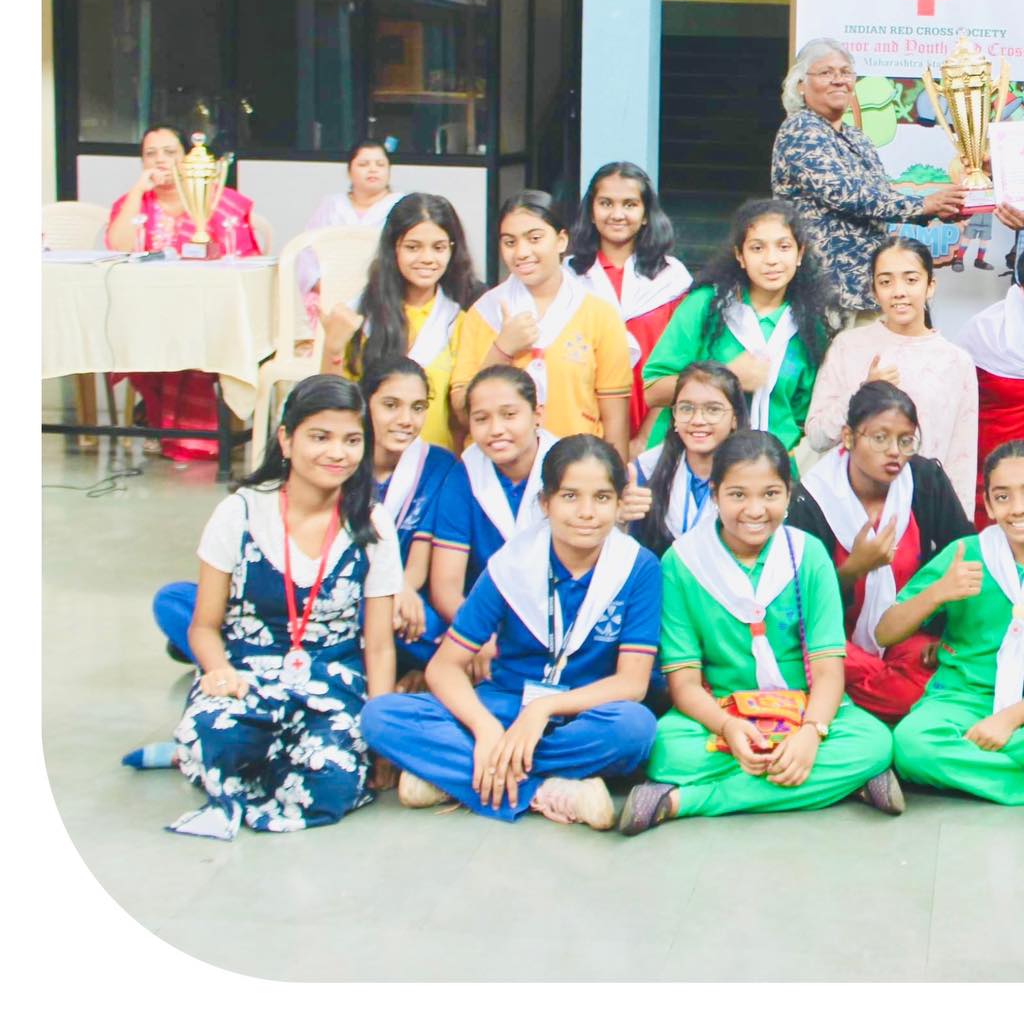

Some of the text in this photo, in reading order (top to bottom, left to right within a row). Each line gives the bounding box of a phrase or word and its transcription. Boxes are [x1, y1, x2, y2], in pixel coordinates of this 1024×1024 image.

[844, 24, 1007, 38] INDIAN RED CROSS CIETY
[874, 40, 899, 53] and
[888, 222, 960, 257] MP
